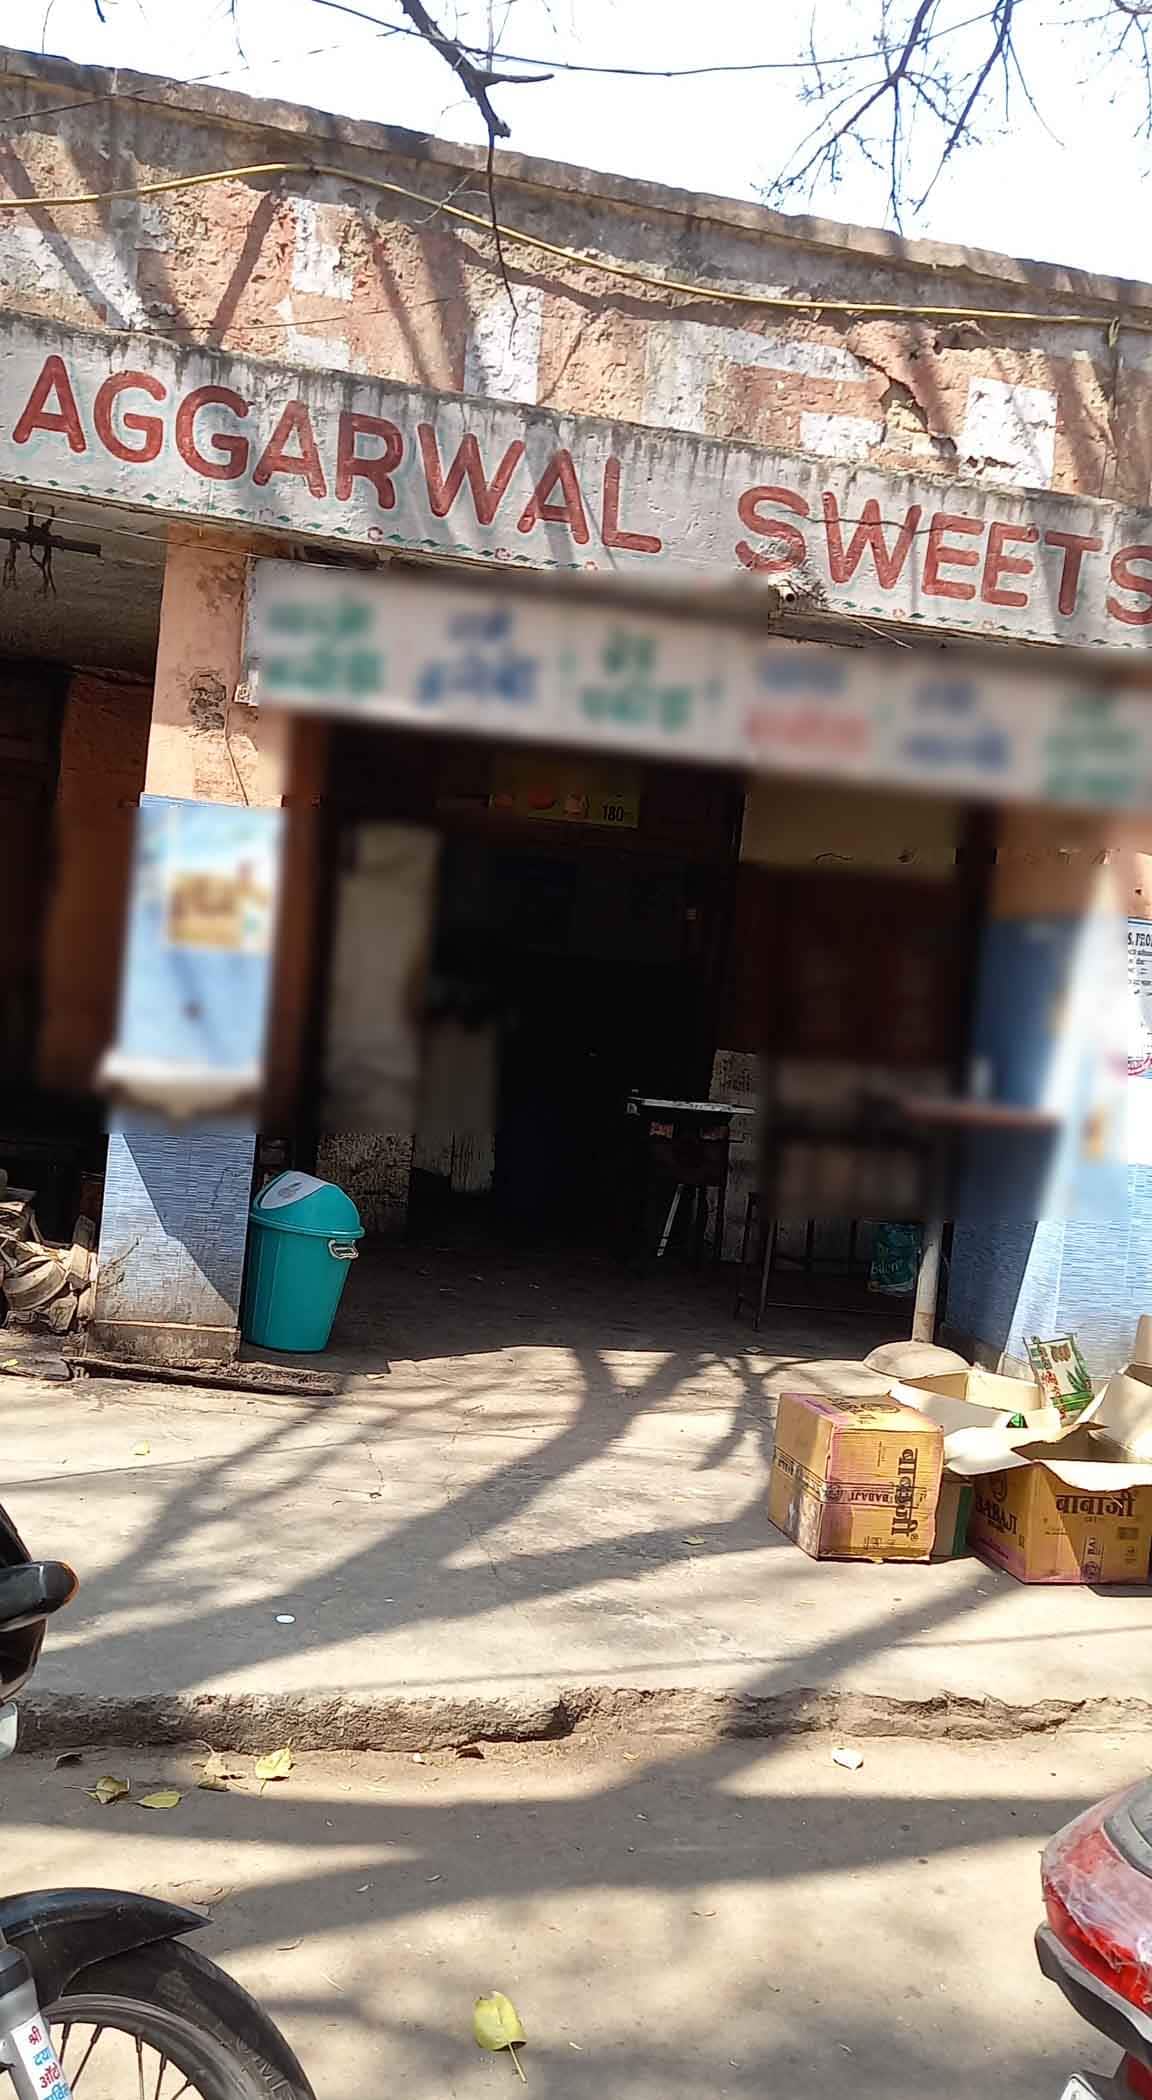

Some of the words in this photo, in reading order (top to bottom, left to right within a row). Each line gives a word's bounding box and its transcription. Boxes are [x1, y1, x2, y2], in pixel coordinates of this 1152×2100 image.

[12, 354, 662, 554] AGGARWAL
[735, 485, 1152, 626] SWEETS
[602, 806, 625, 822] 180
